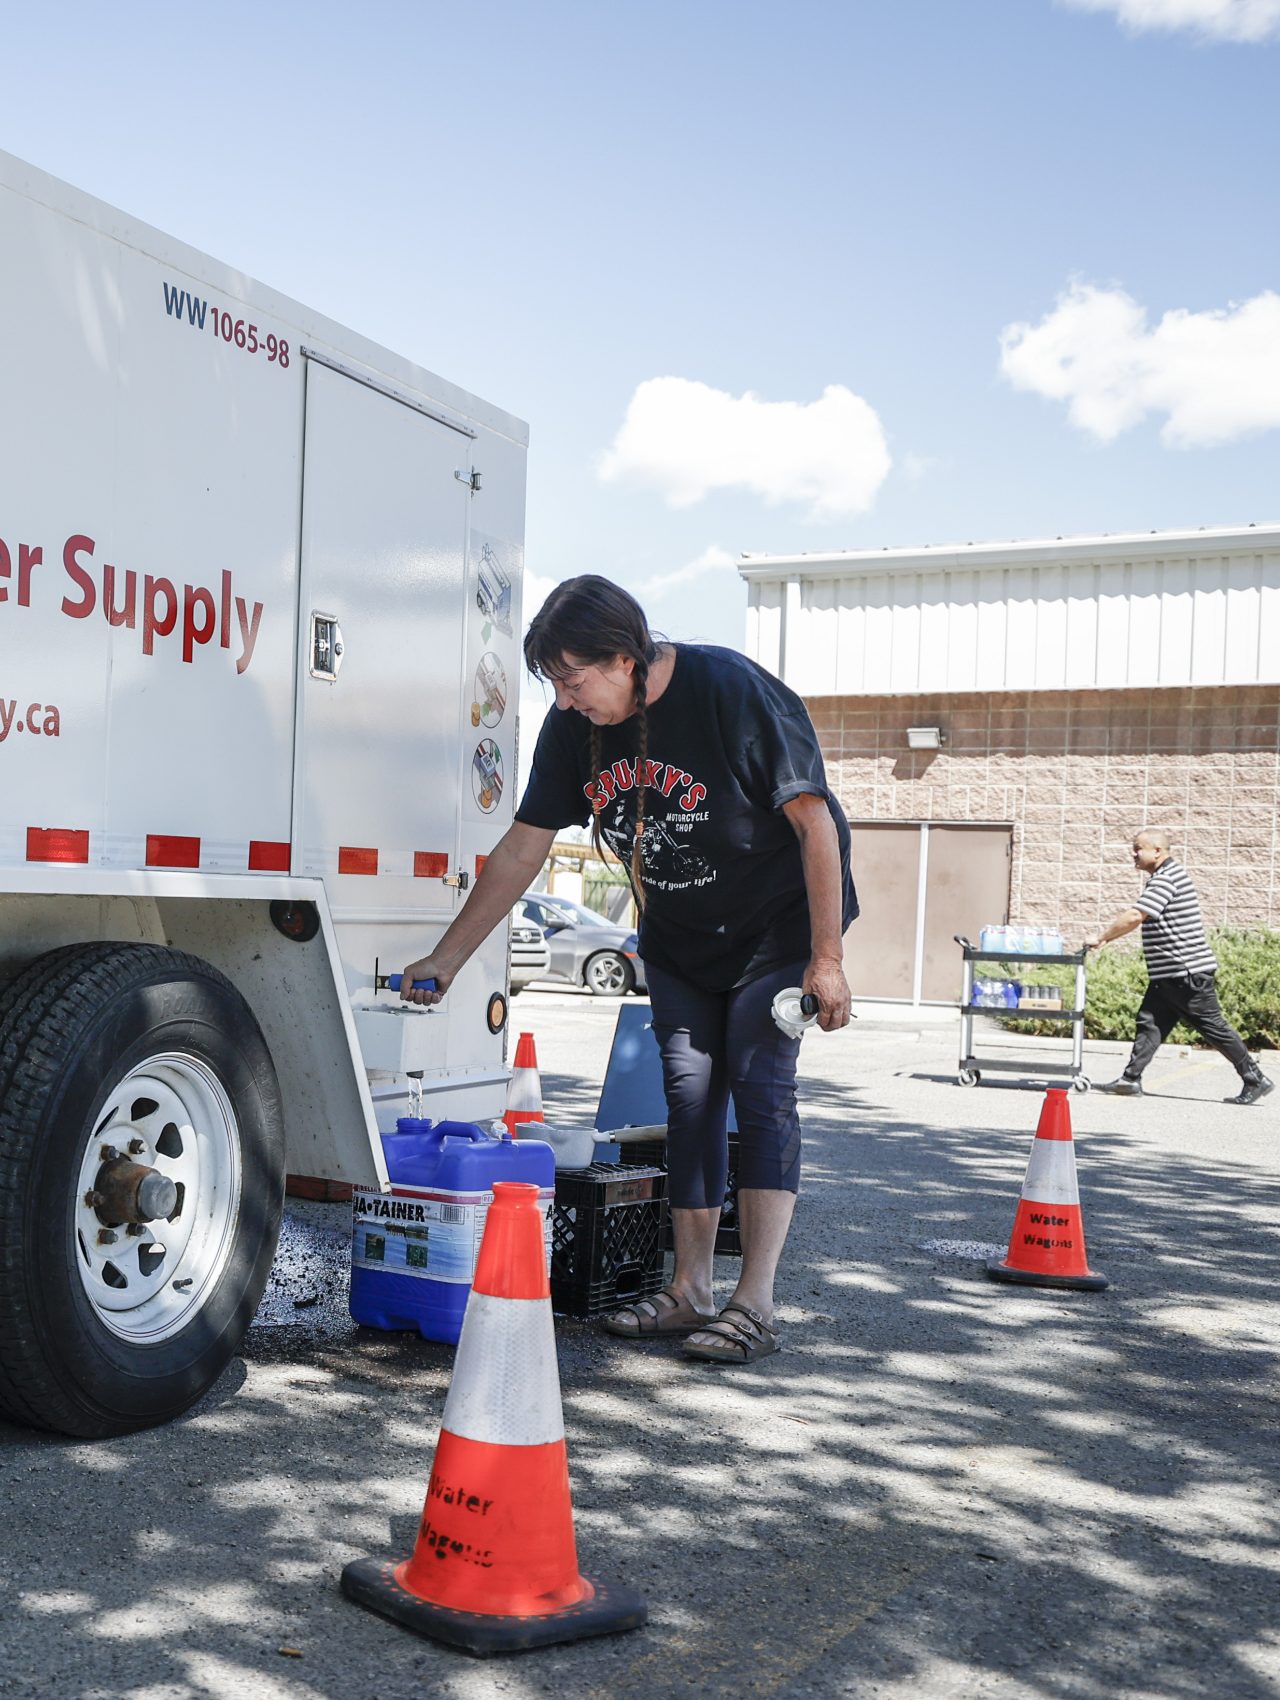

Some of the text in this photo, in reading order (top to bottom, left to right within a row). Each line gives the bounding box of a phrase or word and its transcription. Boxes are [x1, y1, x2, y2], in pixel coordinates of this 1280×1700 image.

[61, 534, 264, 674] Supply
[666, 811, 710, 822] MOTORCYCLE
[675, 823, 694, 832] SHOP
[657, 880, 668, 890] of
[668, 881, 692, 891] your
[1029, 1213, 1070, 1227] Water
[1023, 1233, 1073, 1249] Wagons
[429, 1473, 494, 1516] Water
